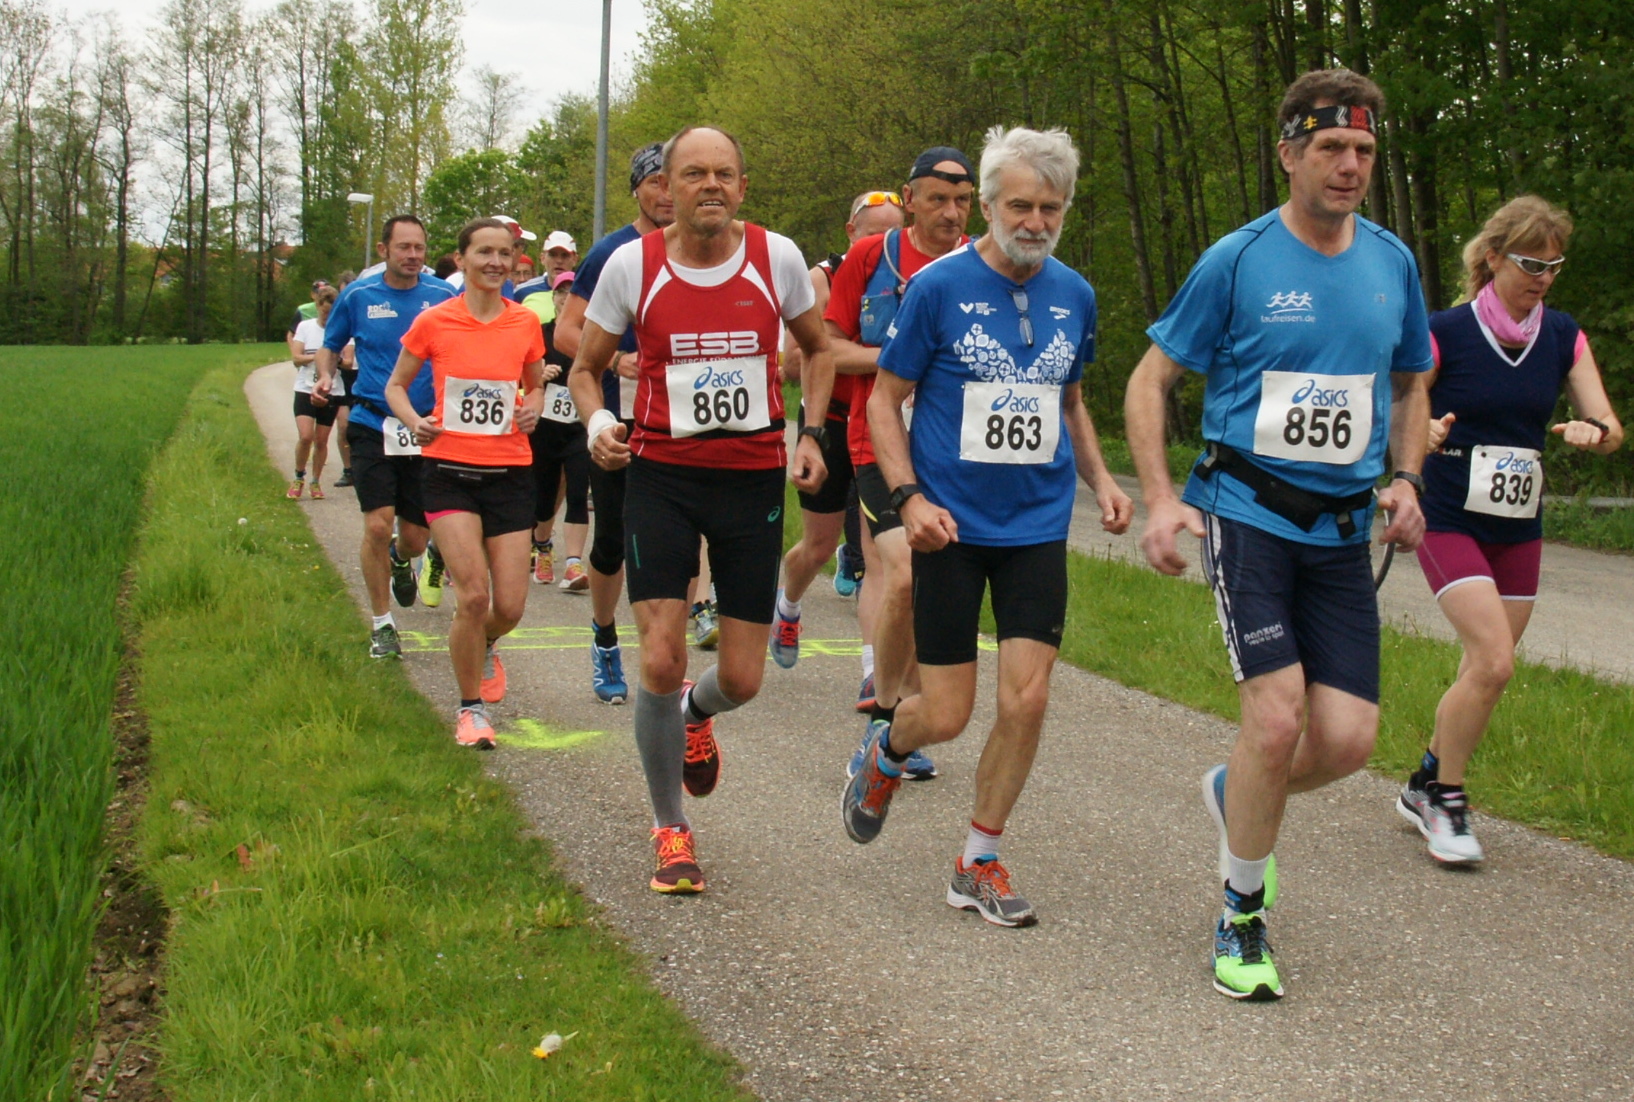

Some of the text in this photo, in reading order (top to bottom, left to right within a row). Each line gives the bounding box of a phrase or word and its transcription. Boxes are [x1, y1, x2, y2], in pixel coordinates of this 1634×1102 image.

[670, 330, 760, 357] ESB
[460, 398, 505, 426] 836
[693, 387, 750, 426] 860
[985, 414, 1042, 452] 863
[1283, 406, 1352, 450] 856
[1489, 472, 1533, 506] 839
